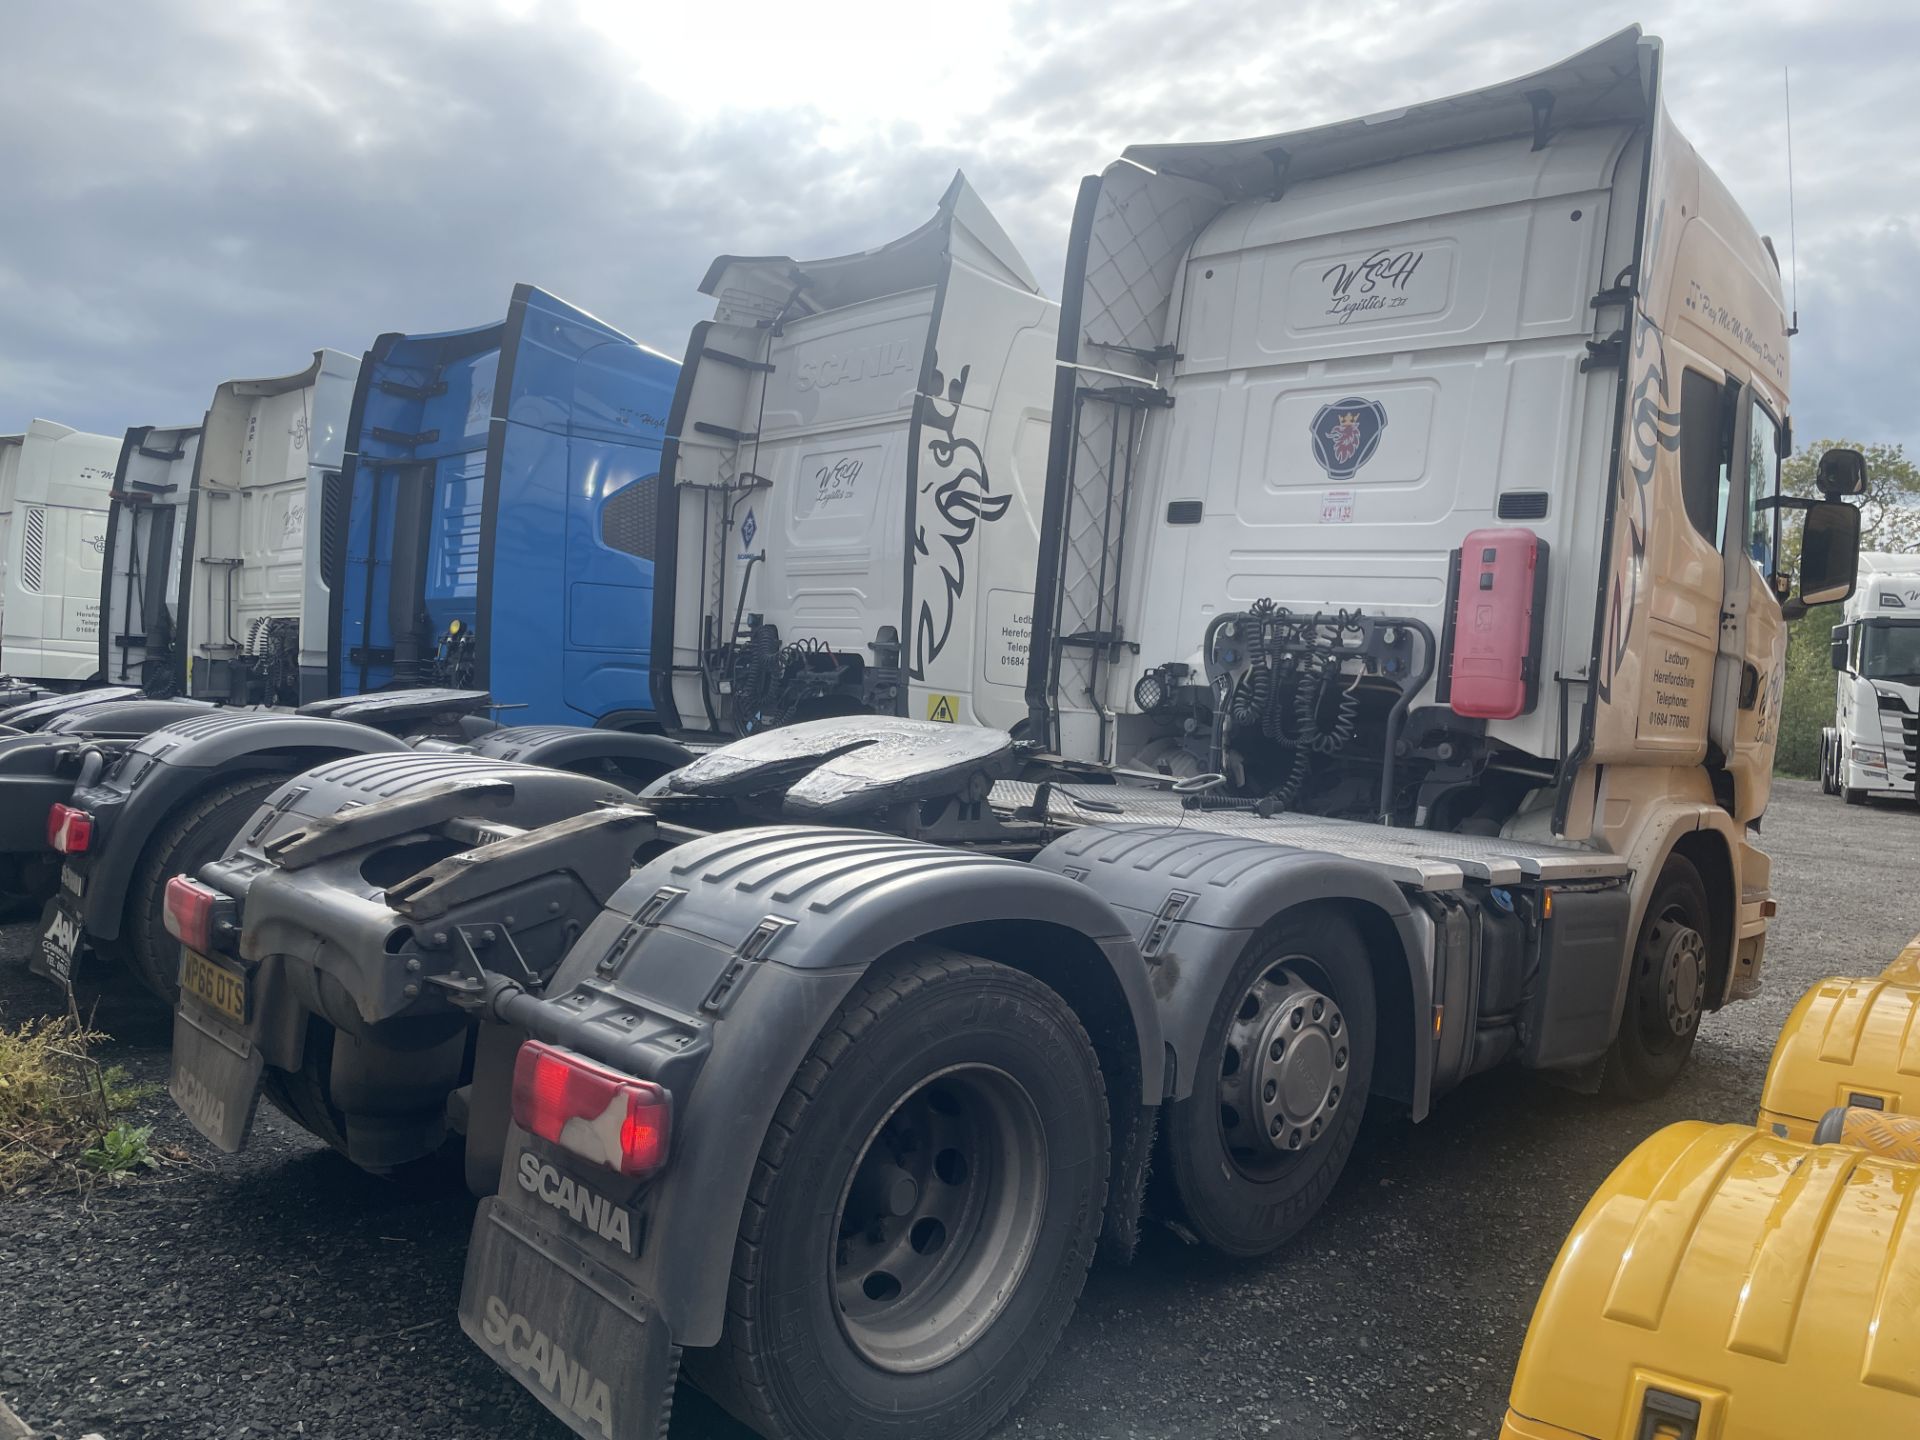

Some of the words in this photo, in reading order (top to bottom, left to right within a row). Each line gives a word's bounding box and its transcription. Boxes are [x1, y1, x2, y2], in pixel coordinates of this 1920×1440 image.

[1325, 295, 1387, 325] Logistics
[797, 340, 914, 392] SCANIA
[1001, 656, 1024, 666] 01684
[1664, 650, 1690, 670] Ledbury
[1653, 669, 1695, 688] Herefordshire
[1656, 690, 1688, 708] Telephone:
[1648, 711, 1668, 727] 01684
[216, 973, 244, 1016] OTS
[177, 1065, 226, 1137] SCANIA
[518, 1152, 632, 1254] SCANIA
[482, 1295, 613, 1440] SCANIA
